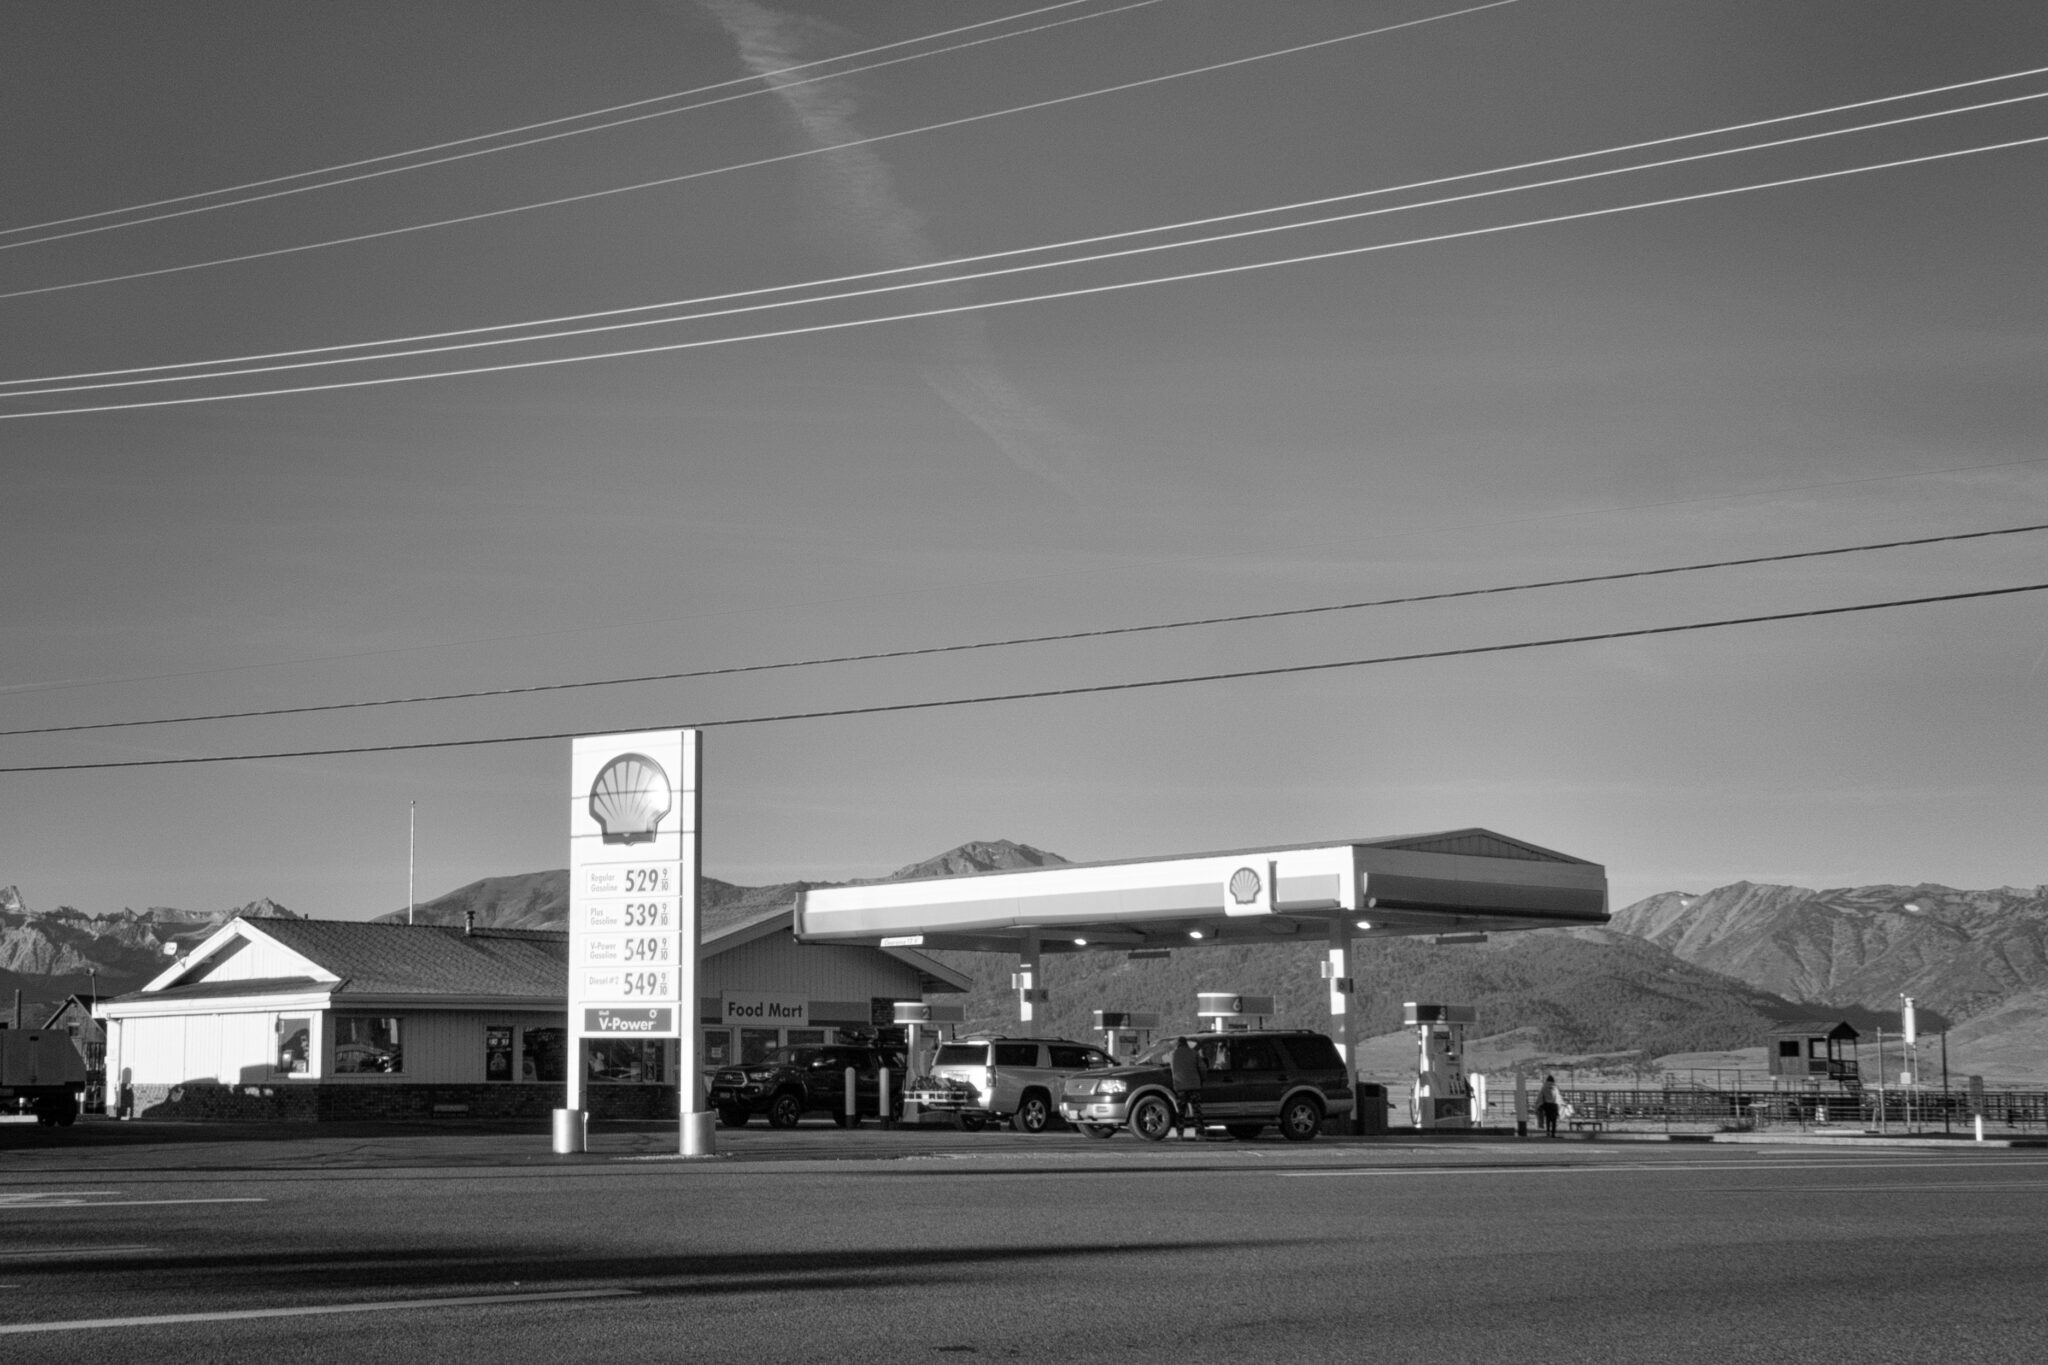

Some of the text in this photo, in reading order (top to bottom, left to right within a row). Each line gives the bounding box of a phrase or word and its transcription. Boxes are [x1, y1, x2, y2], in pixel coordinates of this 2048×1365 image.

[591, 873, 615, 884] Regular
[625, 869, 659, 892] 529
[591, 884, 618, 892] Gasoline
[590, 907, 604, 917] Plus
[624, 903, 658, 926] 539
[590, 916, 618, 926] Gasoline
[590, 942, 616, 950] V-Power
[624, 938, 658, 961] 549
[589, 951, 617, 960] Gasoline
[589, 976, 608, 985] Diesel
[623, 973, 657, 996] 549
[728, 1001, 802, 1018] Food Mart
[1232, 998, 1241, 1012] 6
[922, 1007, 931, 1020] 2
[598, 1017, 656, 1031] V-Power
